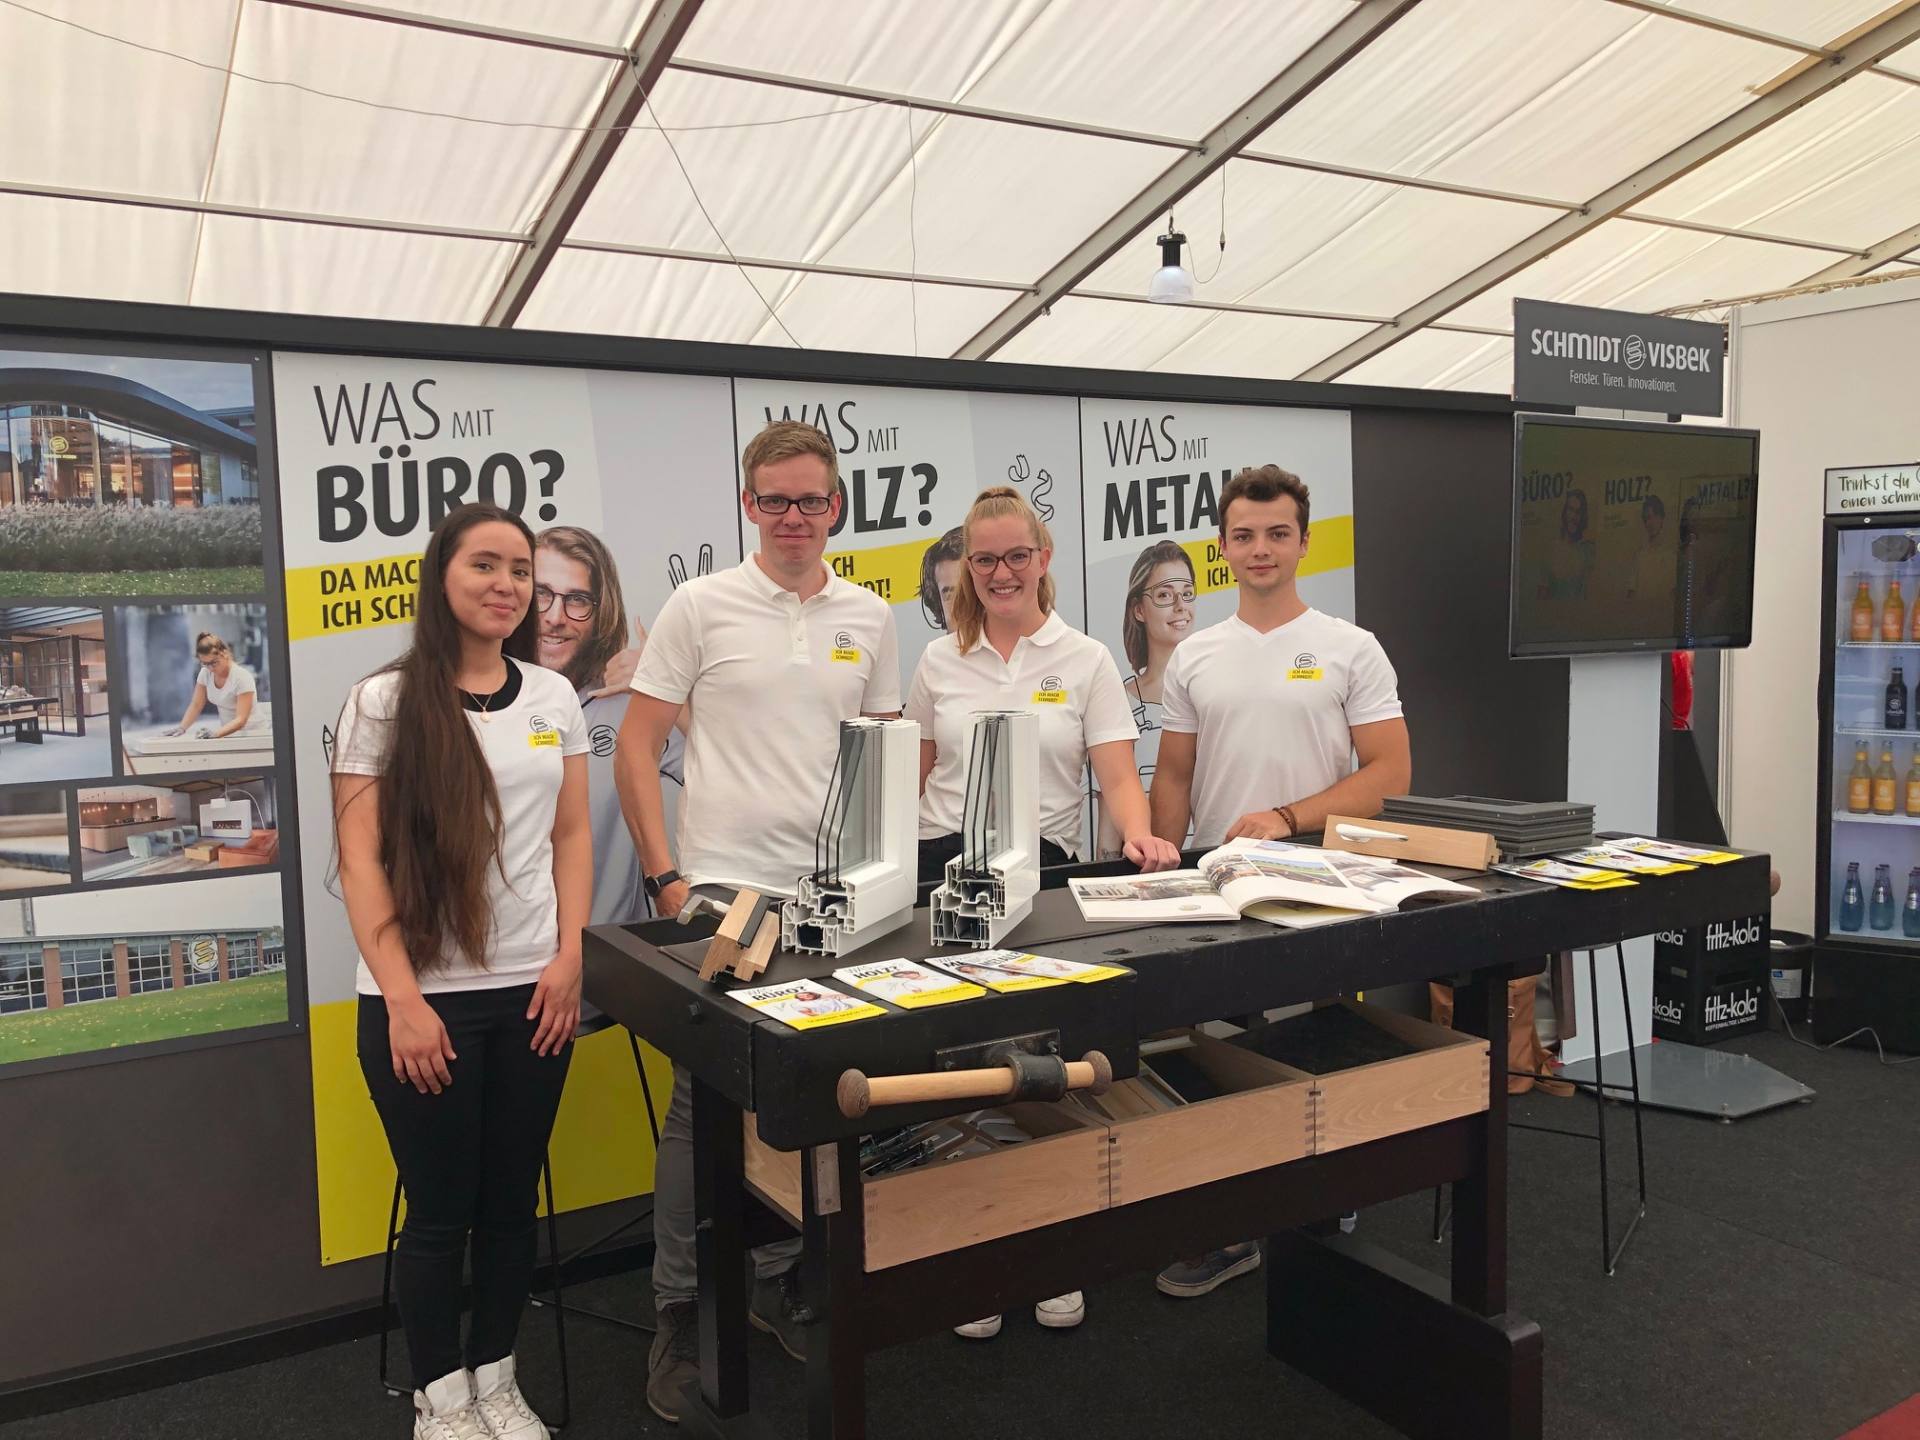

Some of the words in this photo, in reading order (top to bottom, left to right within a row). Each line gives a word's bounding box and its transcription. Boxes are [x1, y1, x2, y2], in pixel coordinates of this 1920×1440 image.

[1628, 376, 1677, 393] Innovationen.
[313, 379, 440, 446] WAS
[452, 409, 494, 439] MIT
[867, 427, 899, 453] MIT
[1103, 415, 1177, 467] WAS
[1183, 437, 1209, 461] MIT
[316, 444, 565, 543] BÜRO?
[1892, 472, 1910, 489] du
[828, 462, 938, 538] LZ?
[320, 567, 356, 595] DA
[364, 558, 424, 590] MAC
[1207, 566, 1229, 588] ICH
[322, 600, 362, 629] ICH
